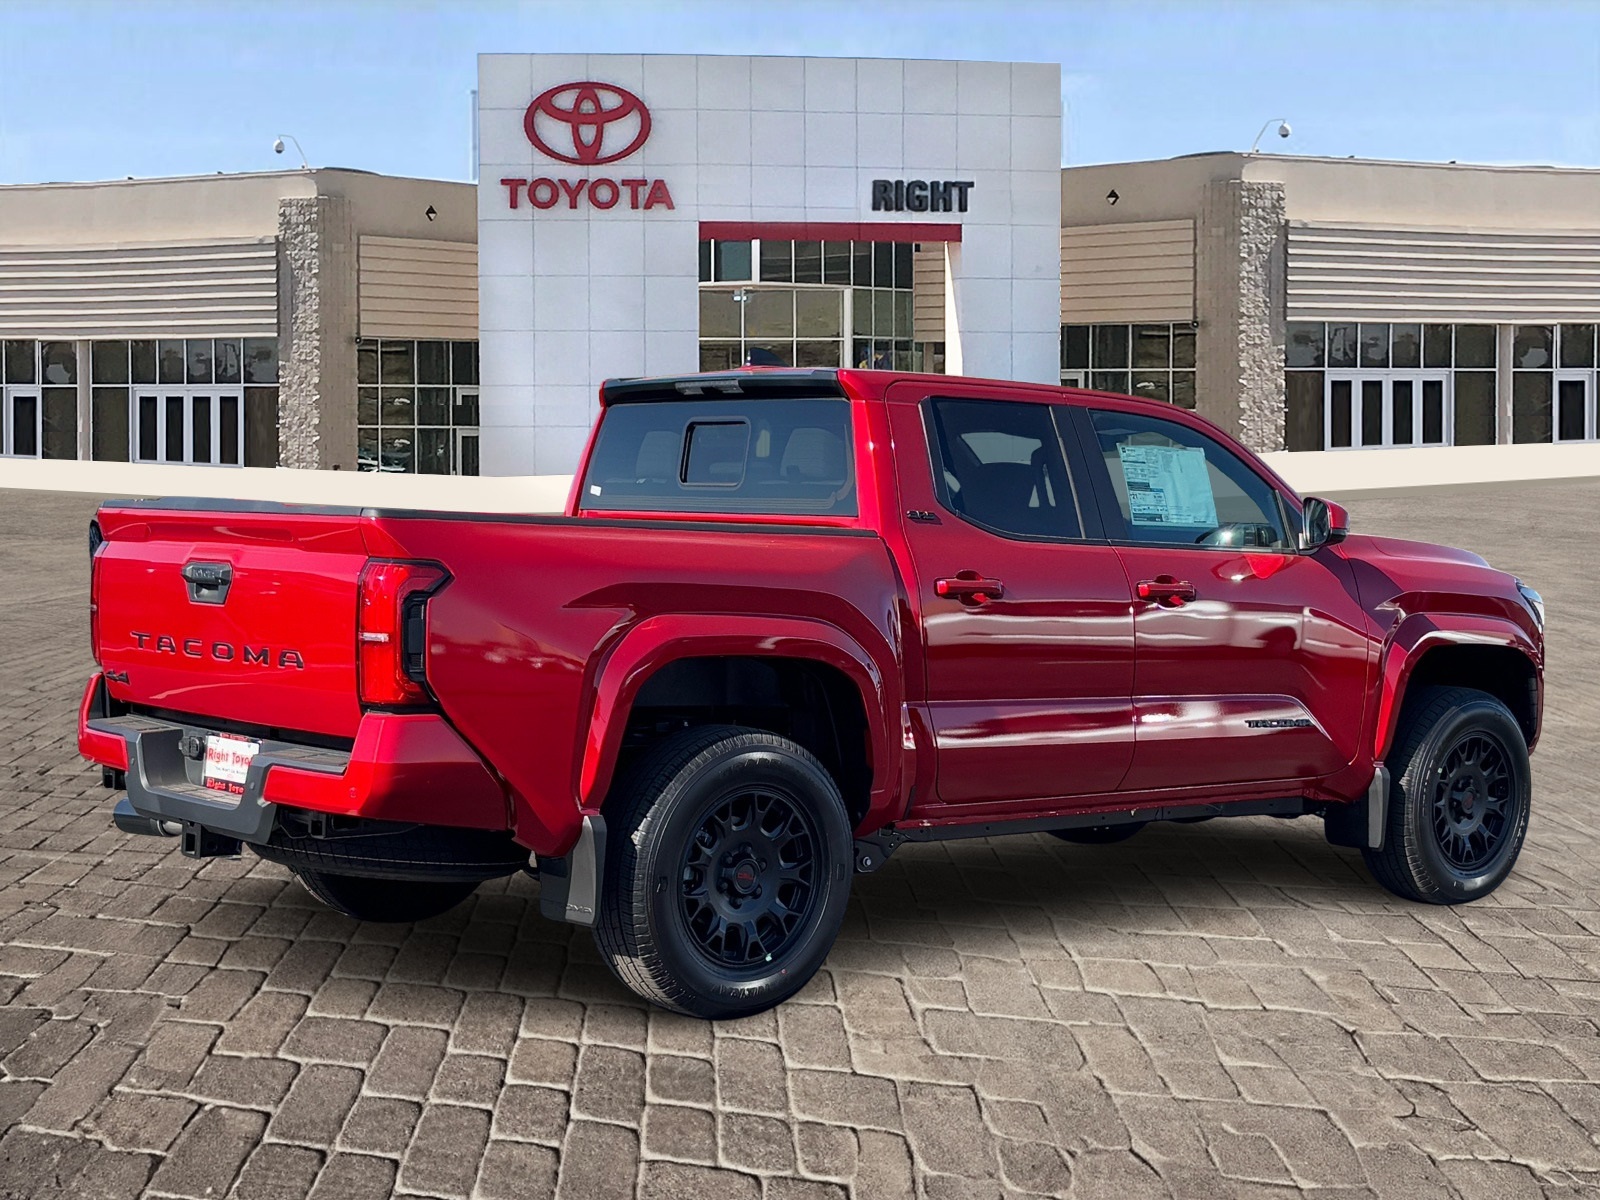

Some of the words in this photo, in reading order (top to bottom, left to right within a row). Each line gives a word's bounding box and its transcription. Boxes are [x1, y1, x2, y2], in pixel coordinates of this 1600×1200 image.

[500, 177, 675, 210] TOYOTA
[871, 179, 975, 213] RIGHT
[130, 631, 304, 670] TACOMA
[208, 747, 229, 763] Right
